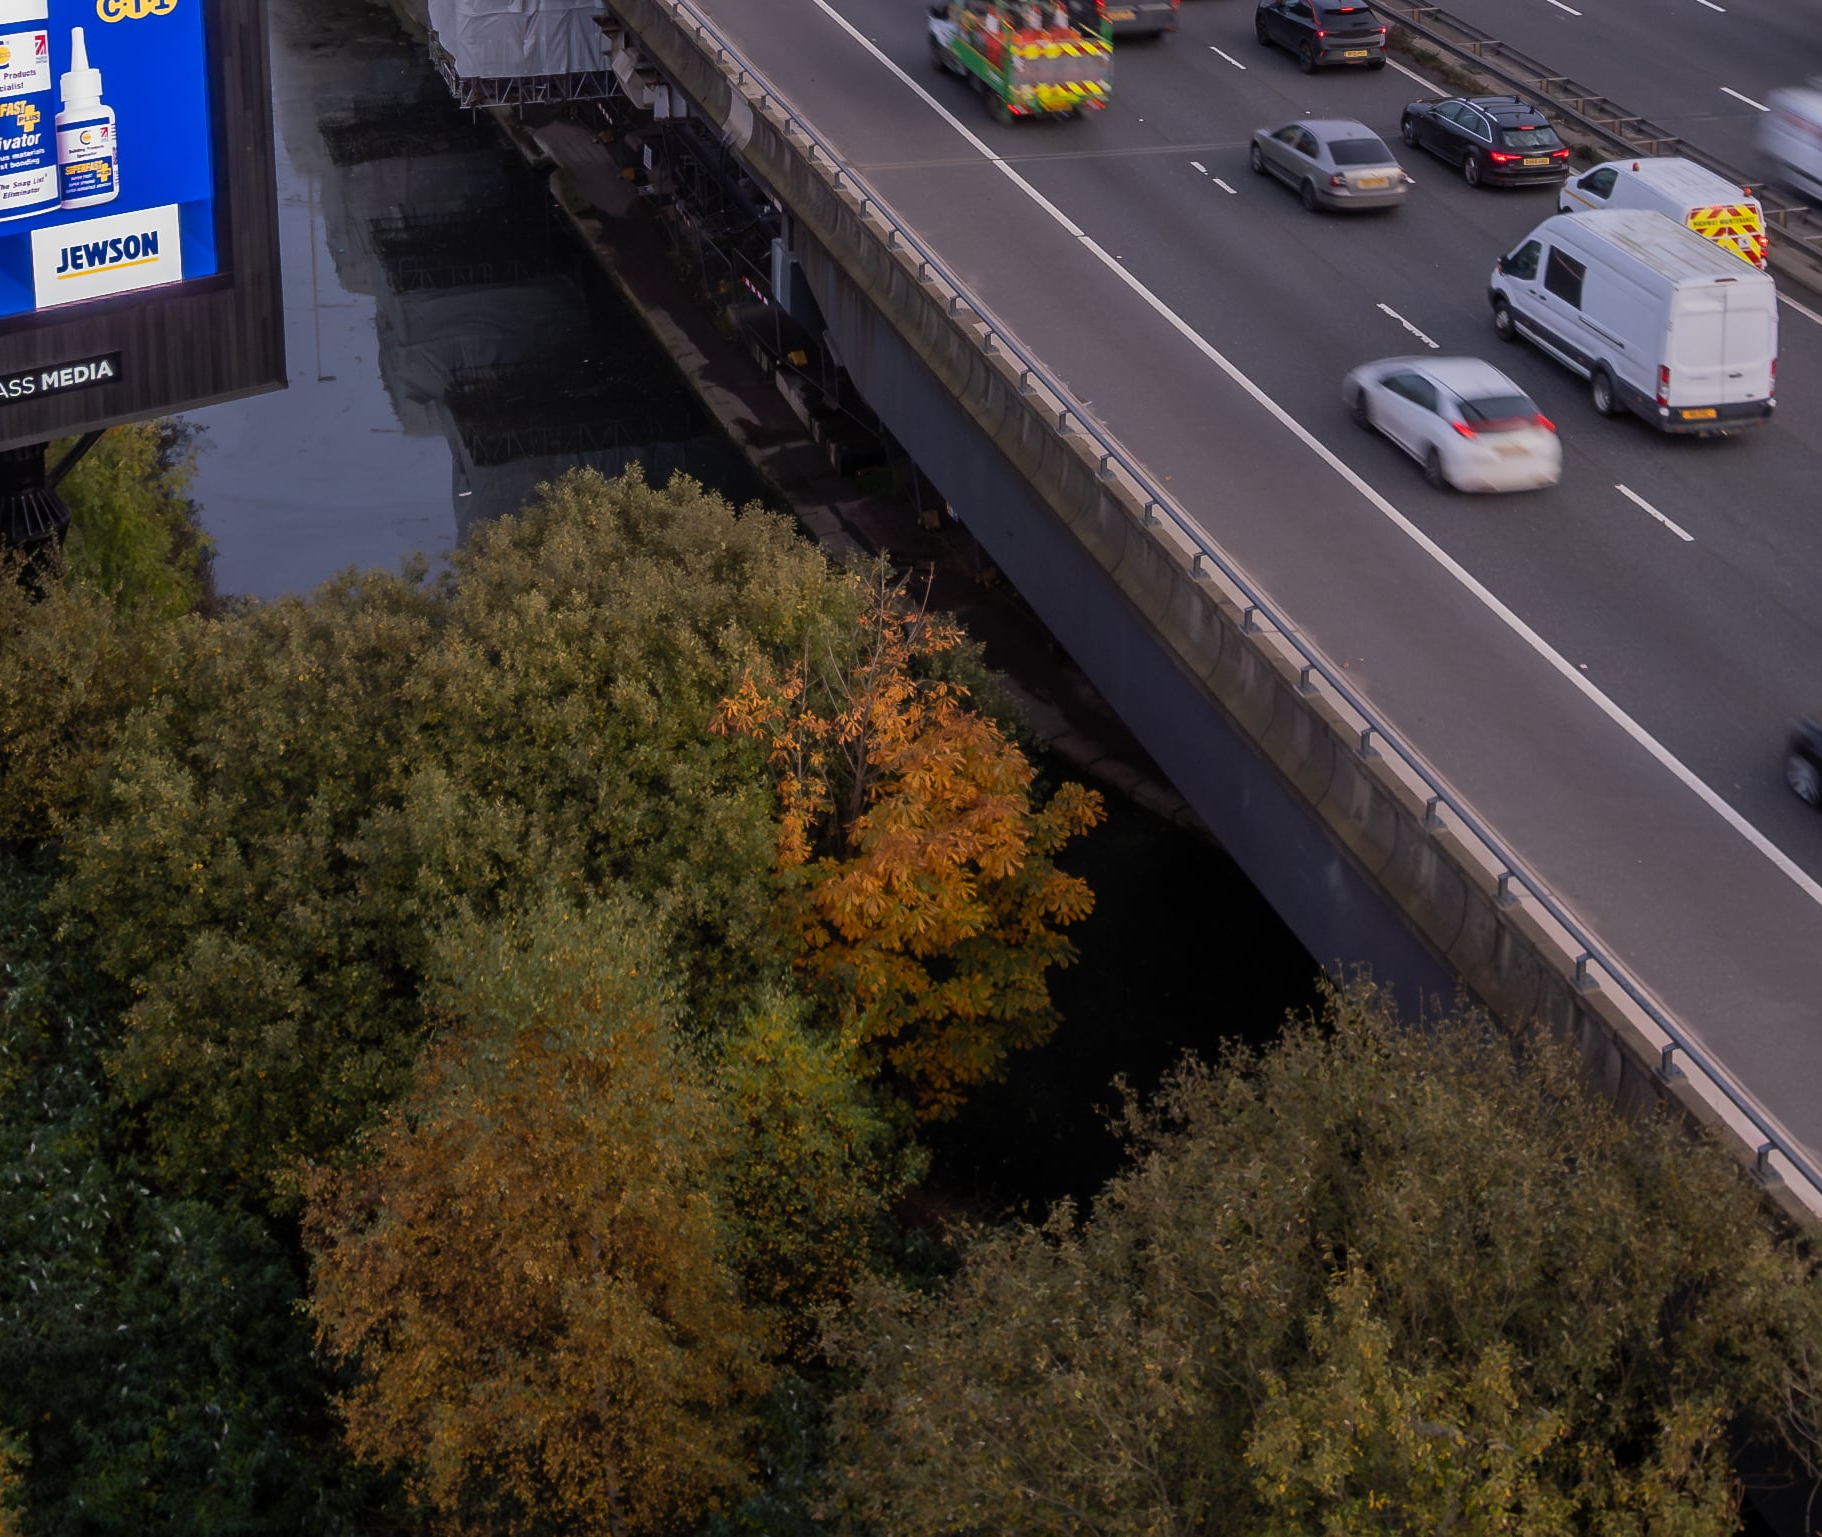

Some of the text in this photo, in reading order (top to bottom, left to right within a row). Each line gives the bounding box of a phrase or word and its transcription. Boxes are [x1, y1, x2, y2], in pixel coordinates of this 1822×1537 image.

[3, 69, 37, 81] Products
[57, 231, 159, 274] JEWSON
[41, 360, 113, 392] MEDIA
